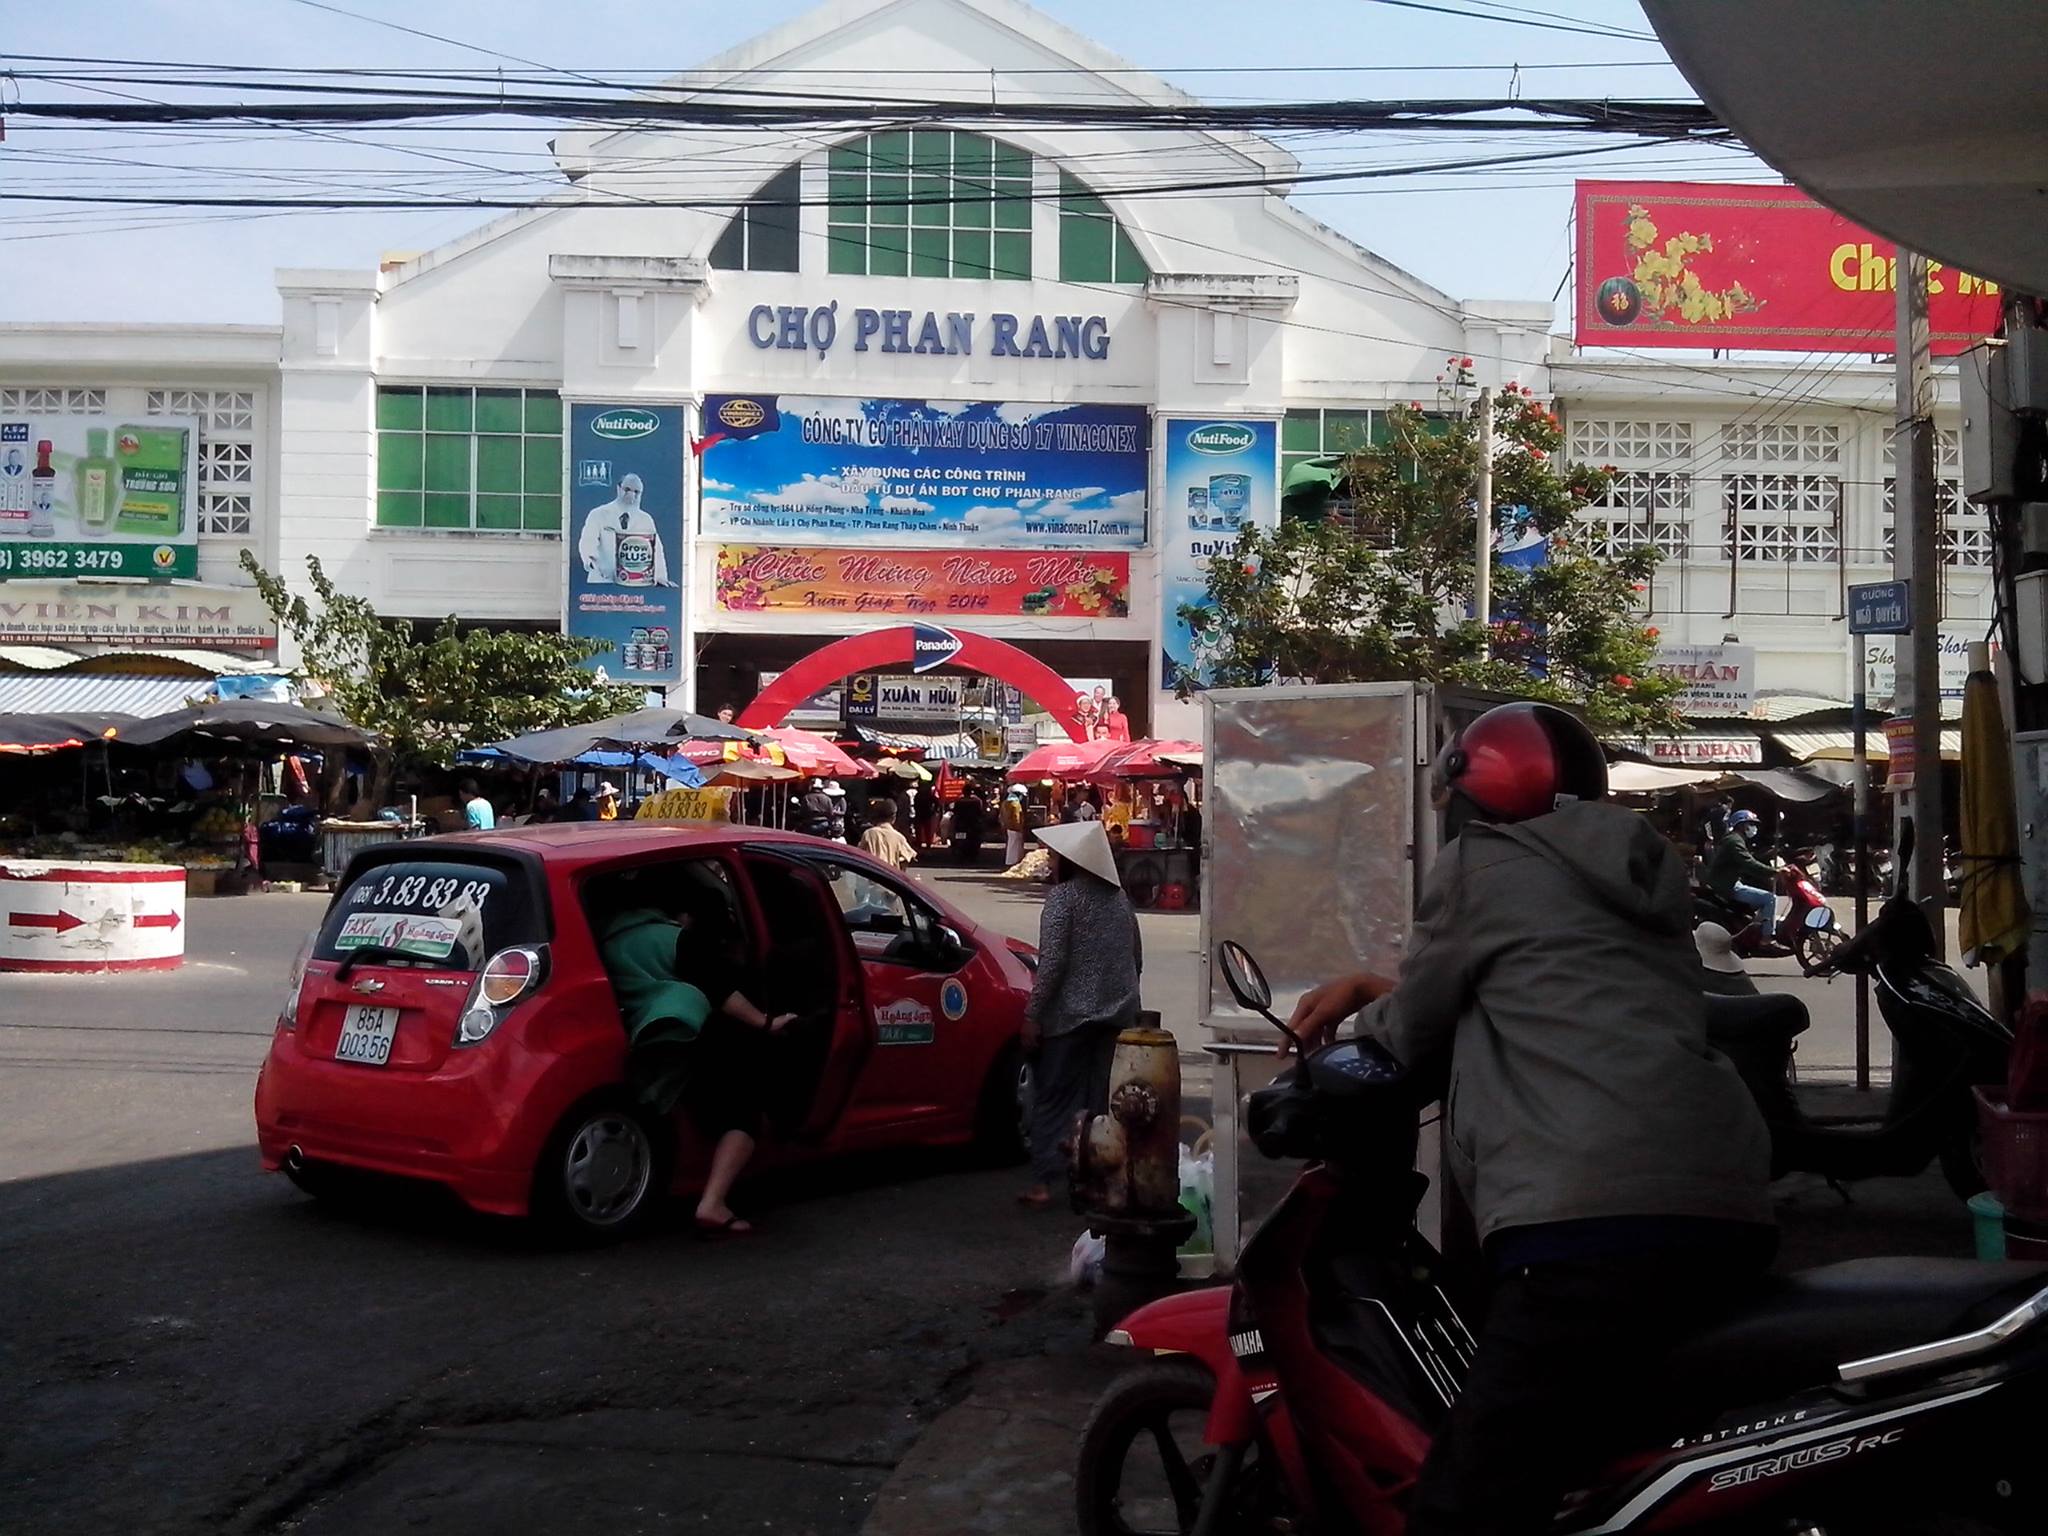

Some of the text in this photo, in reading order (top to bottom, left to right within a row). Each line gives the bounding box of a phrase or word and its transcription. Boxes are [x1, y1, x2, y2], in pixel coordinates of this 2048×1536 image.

[748, 299, 1111, 361] CHỢ PHAN RANG
[802, 410, 842, 445] CÔNG
[845, 418, 865, 445] TY
[891, 411, 933, 448] PHẦN
[934, 414, 966, 448] XÂY
[967, 417, 1009, 454] DỰNG
[1010, 413, 1032, 450] SỐ
[1035, 423, 1053, 450] 17
[1056, 424, 1137, 452] VINACONEX
[841, 464, 1026, 482] XÂY DỰNG CÁC CÔNG TRÌNH
[895, 484, 915, 497] DỰ
[919, 484, 937, 496] ÁN
[942, 486, 969, 497] BOT
[973, 485, 1003, 499] CHỢ
[1005, 487, 1042, 499] PHAN
[812, 519, 828, 528] Phan
[830, 520, 847, 530] Rang
[865, 520, 881, 530] Phan
[882, 520, 899, 531] Rang
[1026, 518, 1130, 536] www.vinaconex17.com.vn
[621, 541, 649, 552] Grow
[1190, 539, 1238, 558] nuVit
[20, 550, 68, 568] 3962
[74, 551, 123, 569] 3479
[750, 551, 828, 583] Chúc
[942, 554, 1019, 586] Năm
[947, 593, 990, 609] 2014
[137, 605, 232, 620] KIM
[915, 639, 958, 651] Panadol
[1865, 646, 1896, 665] Sho
[881, 685, 921, 703] XUÂN
[928, 685, 957, 704] HỮU
[663, 791, 701, 801] TAXI
[343, 915, 378, 935] TAXI
[356, 1007, 385, 1032] 85A
[340, 1032, 390, 1060] 003.56
[1707, 1428, 1905, 1493] SIRIUS RC
